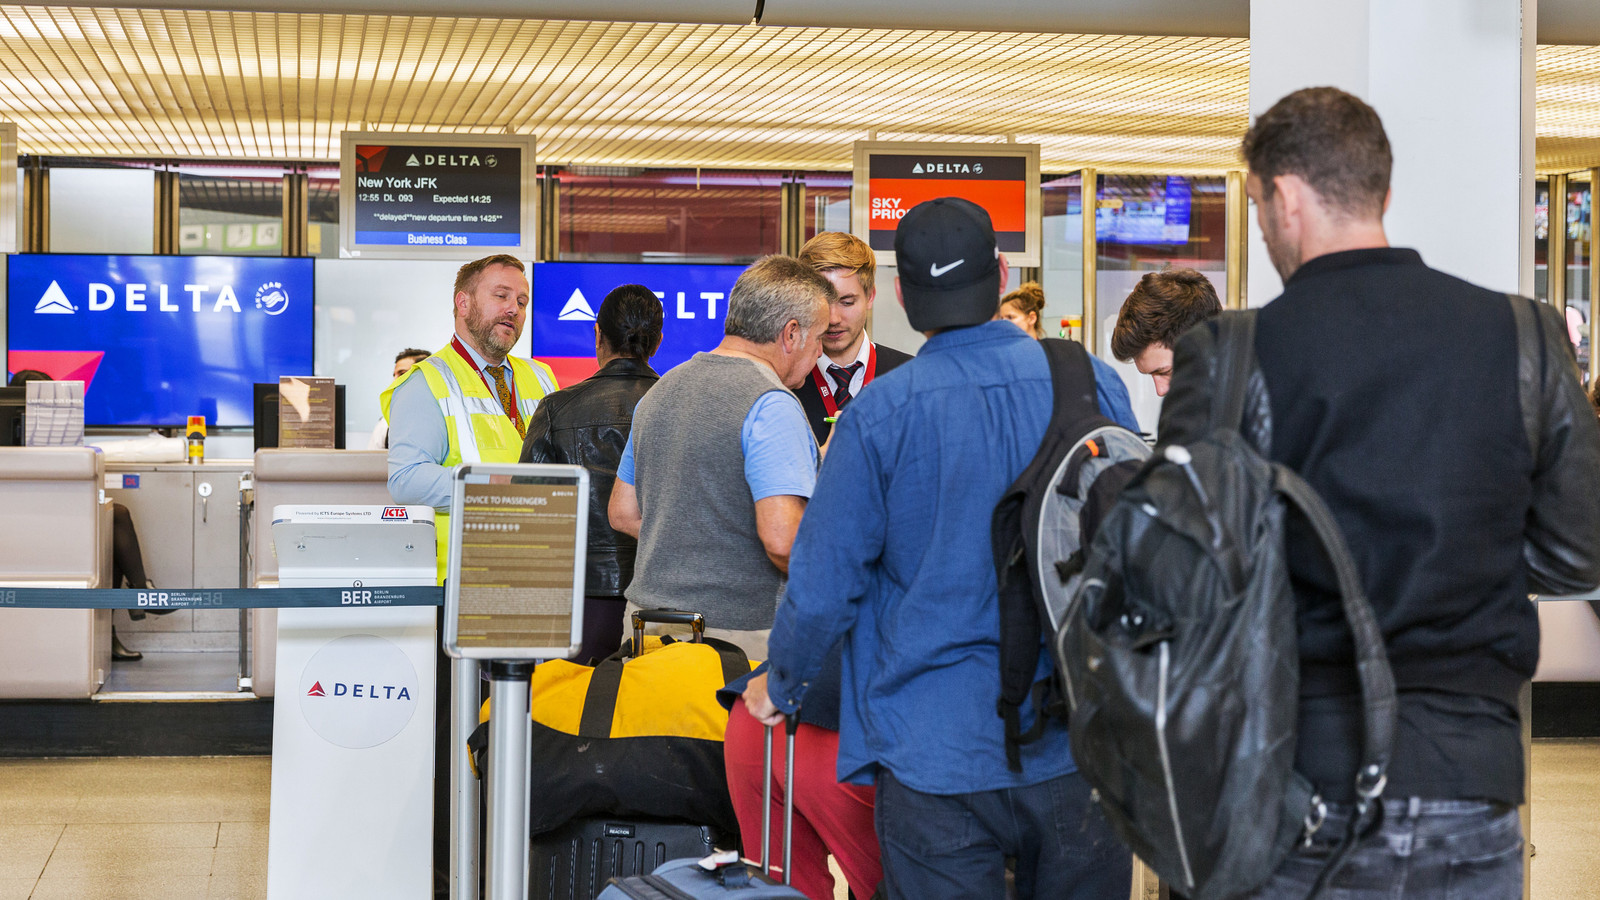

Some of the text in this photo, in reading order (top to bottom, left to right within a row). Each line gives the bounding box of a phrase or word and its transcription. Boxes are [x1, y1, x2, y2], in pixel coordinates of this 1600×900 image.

[424, 154, 481, 167] DELTA
[926, 163, 970, 174] DELTA
[358, 177, 438, 189] New York JFK
[358, 194, 492, 204] 12:55 DL 093 Expected 14:25
[872, 197, 902, 209] SKY
[428, 214, 462, 223] departure
[463, 214, 478, 222] time
[872, 208, 910, 220] PRIO
[408, 234, 468, 245] Business Class
[88, 282, 242, 313] DELTA
[463, 495, 548, 506] DVICE TO PASSENGERS
[384, 508, 406, 517] ICTS
[137, 592, 169, 607] BER
[341, 590, 372, 605] BER
[333, 682, 411, 701] DELTA
